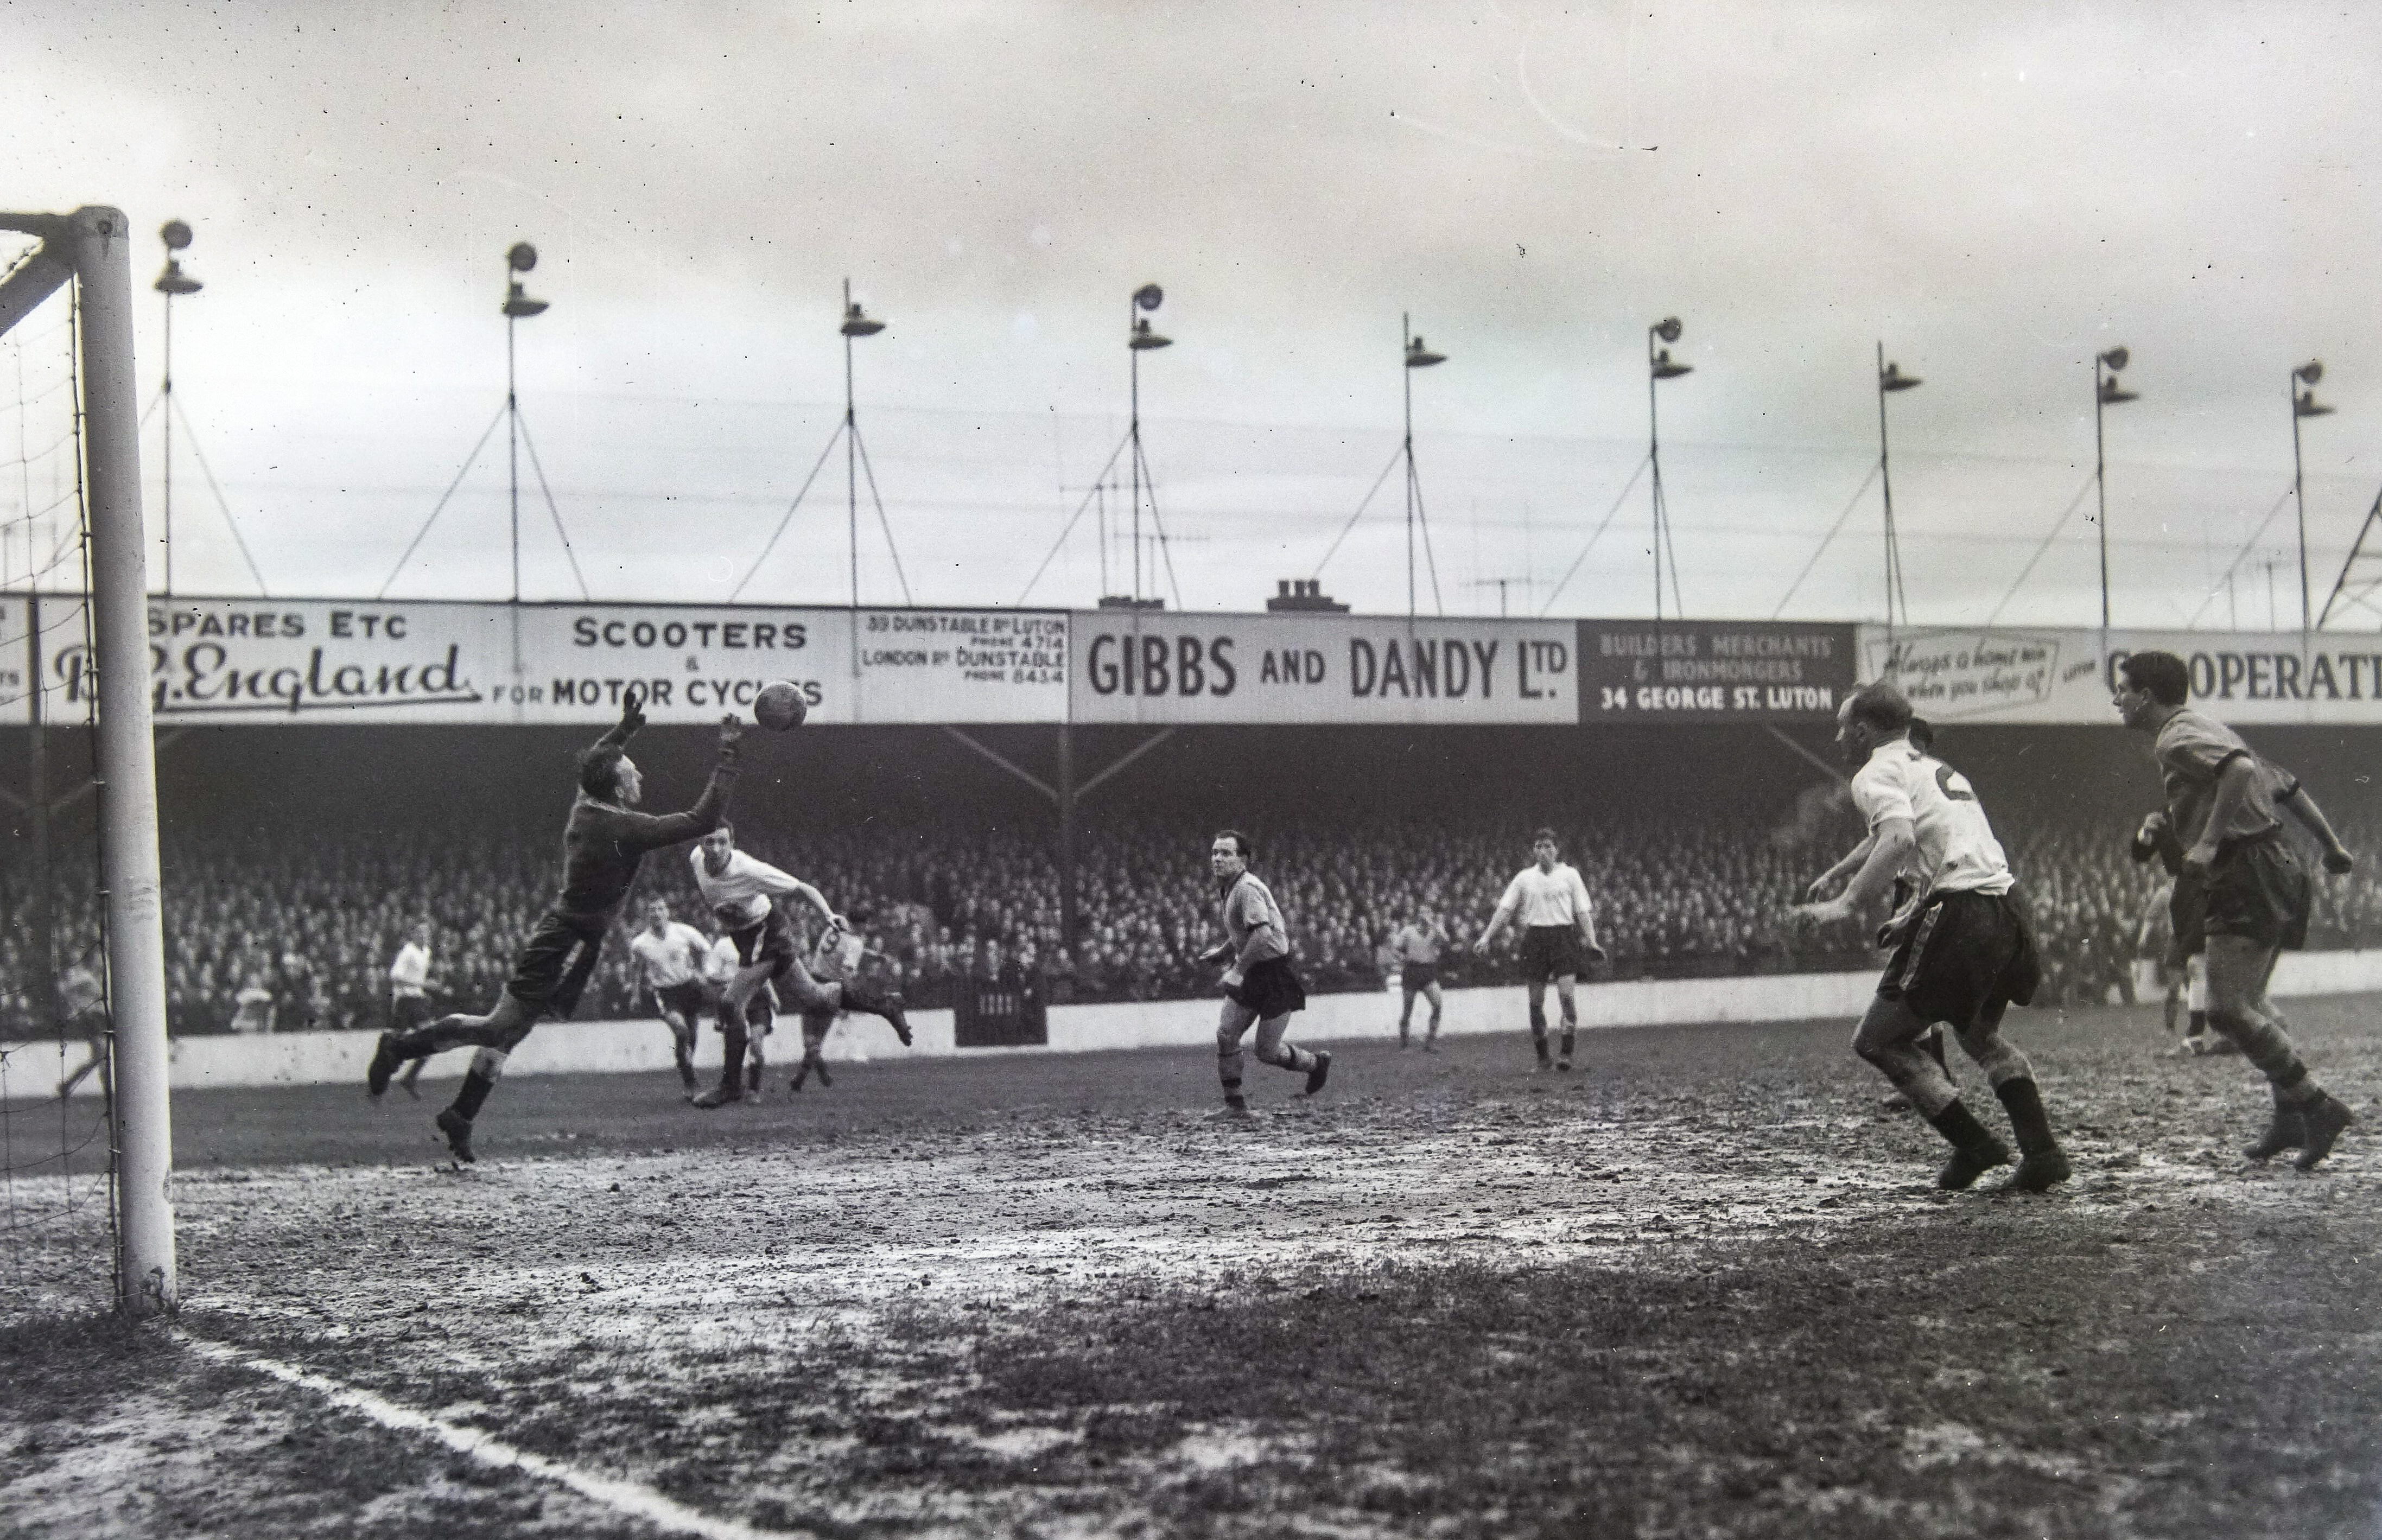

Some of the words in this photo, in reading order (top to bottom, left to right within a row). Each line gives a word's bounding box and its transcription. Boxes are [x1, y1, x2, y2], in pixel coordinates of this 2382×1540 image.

[148, 608, 306, 638] SPARES
[331, 611, 407, 639] ETC
[574, 615, 807, 648] SCOOTERS
[893, 617, 989, 634] DUNSTABLE
[1013, 618, 1065, 635] LUTON
[1600, 634, 1696, 657] BUILDERS
[1712, 635, 1832, 658] MERCHANTS
[862, 651, 928, 666] LONDON
[957, 651, 1063, 668] DUNSTABLE
[1088, 634, 1236, 697] GIBBS
[1260, 650, 1326, 684] AND
[1349, 638, 1499, 699] DANDY
[1662, 659, 1802, 681] IRONMONGERS
[492, 684, 543, 704] FOR
[552, 679, 673, 706] MOTOR
[686, 678, 823, 706] CYCS
[1600, 686, 1628, 710] 34
[1636, 686, 1725, 710] GEORGE
[1767, 686, 1833, 710] LUTON
[1935, 762, 1976, 801] 2
